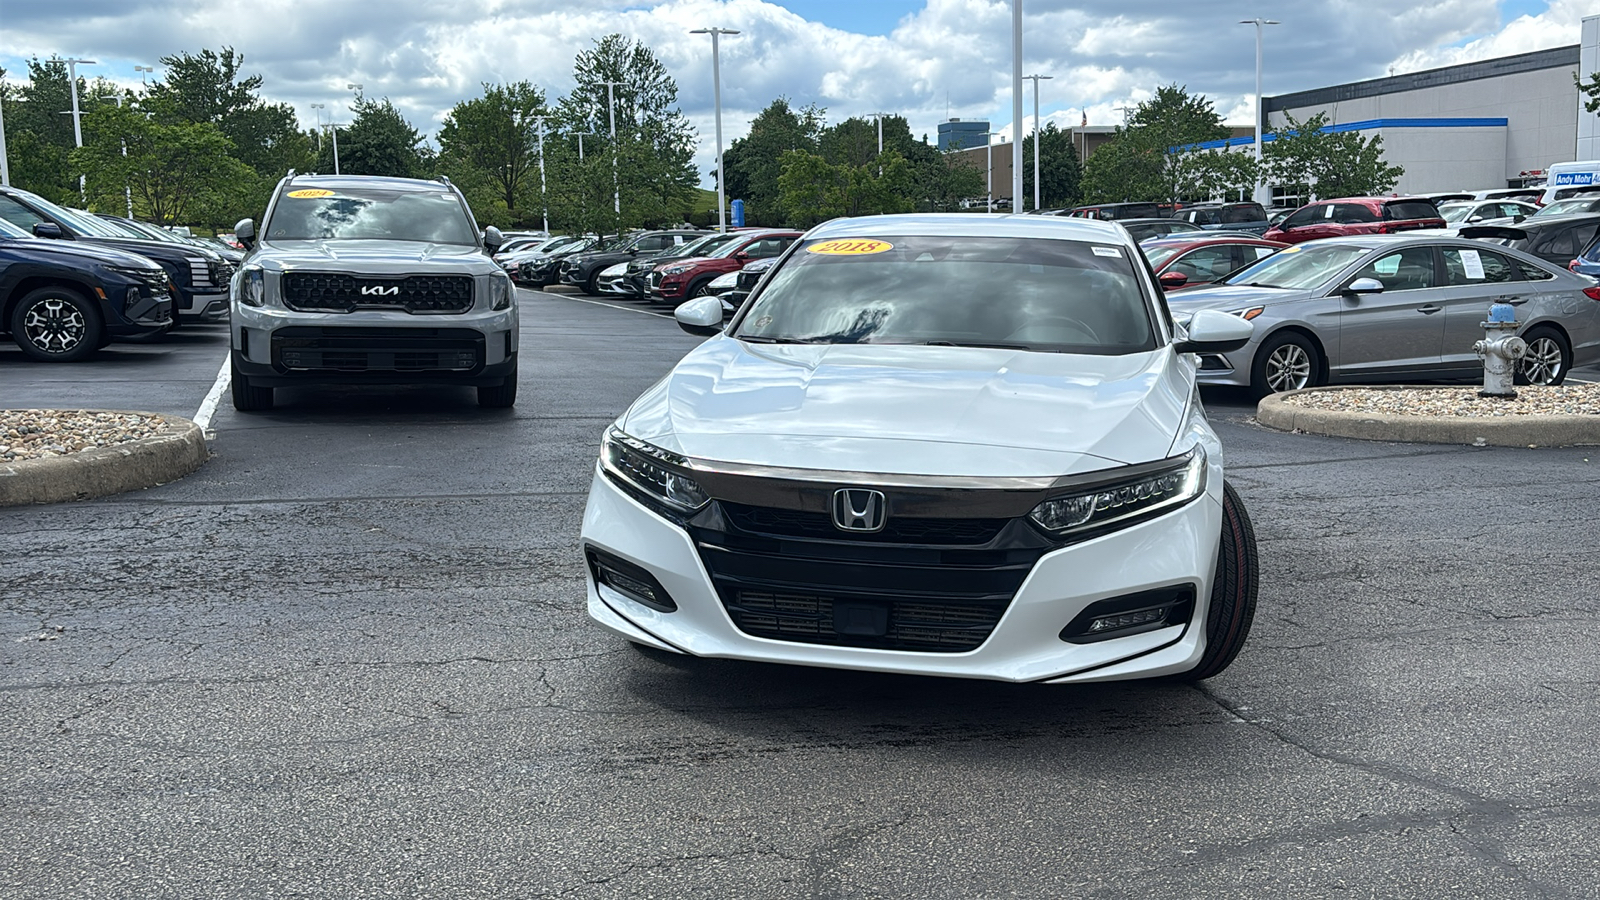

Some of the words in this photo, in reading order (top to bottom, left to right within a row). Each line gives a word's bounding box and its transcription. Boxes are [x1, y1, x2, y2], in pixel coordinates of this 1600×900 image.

[1556, 175, 1573, 185] Andy
[1574, 174, 1592, 183] Mohr
[818, 242, 881, 252] 2018
